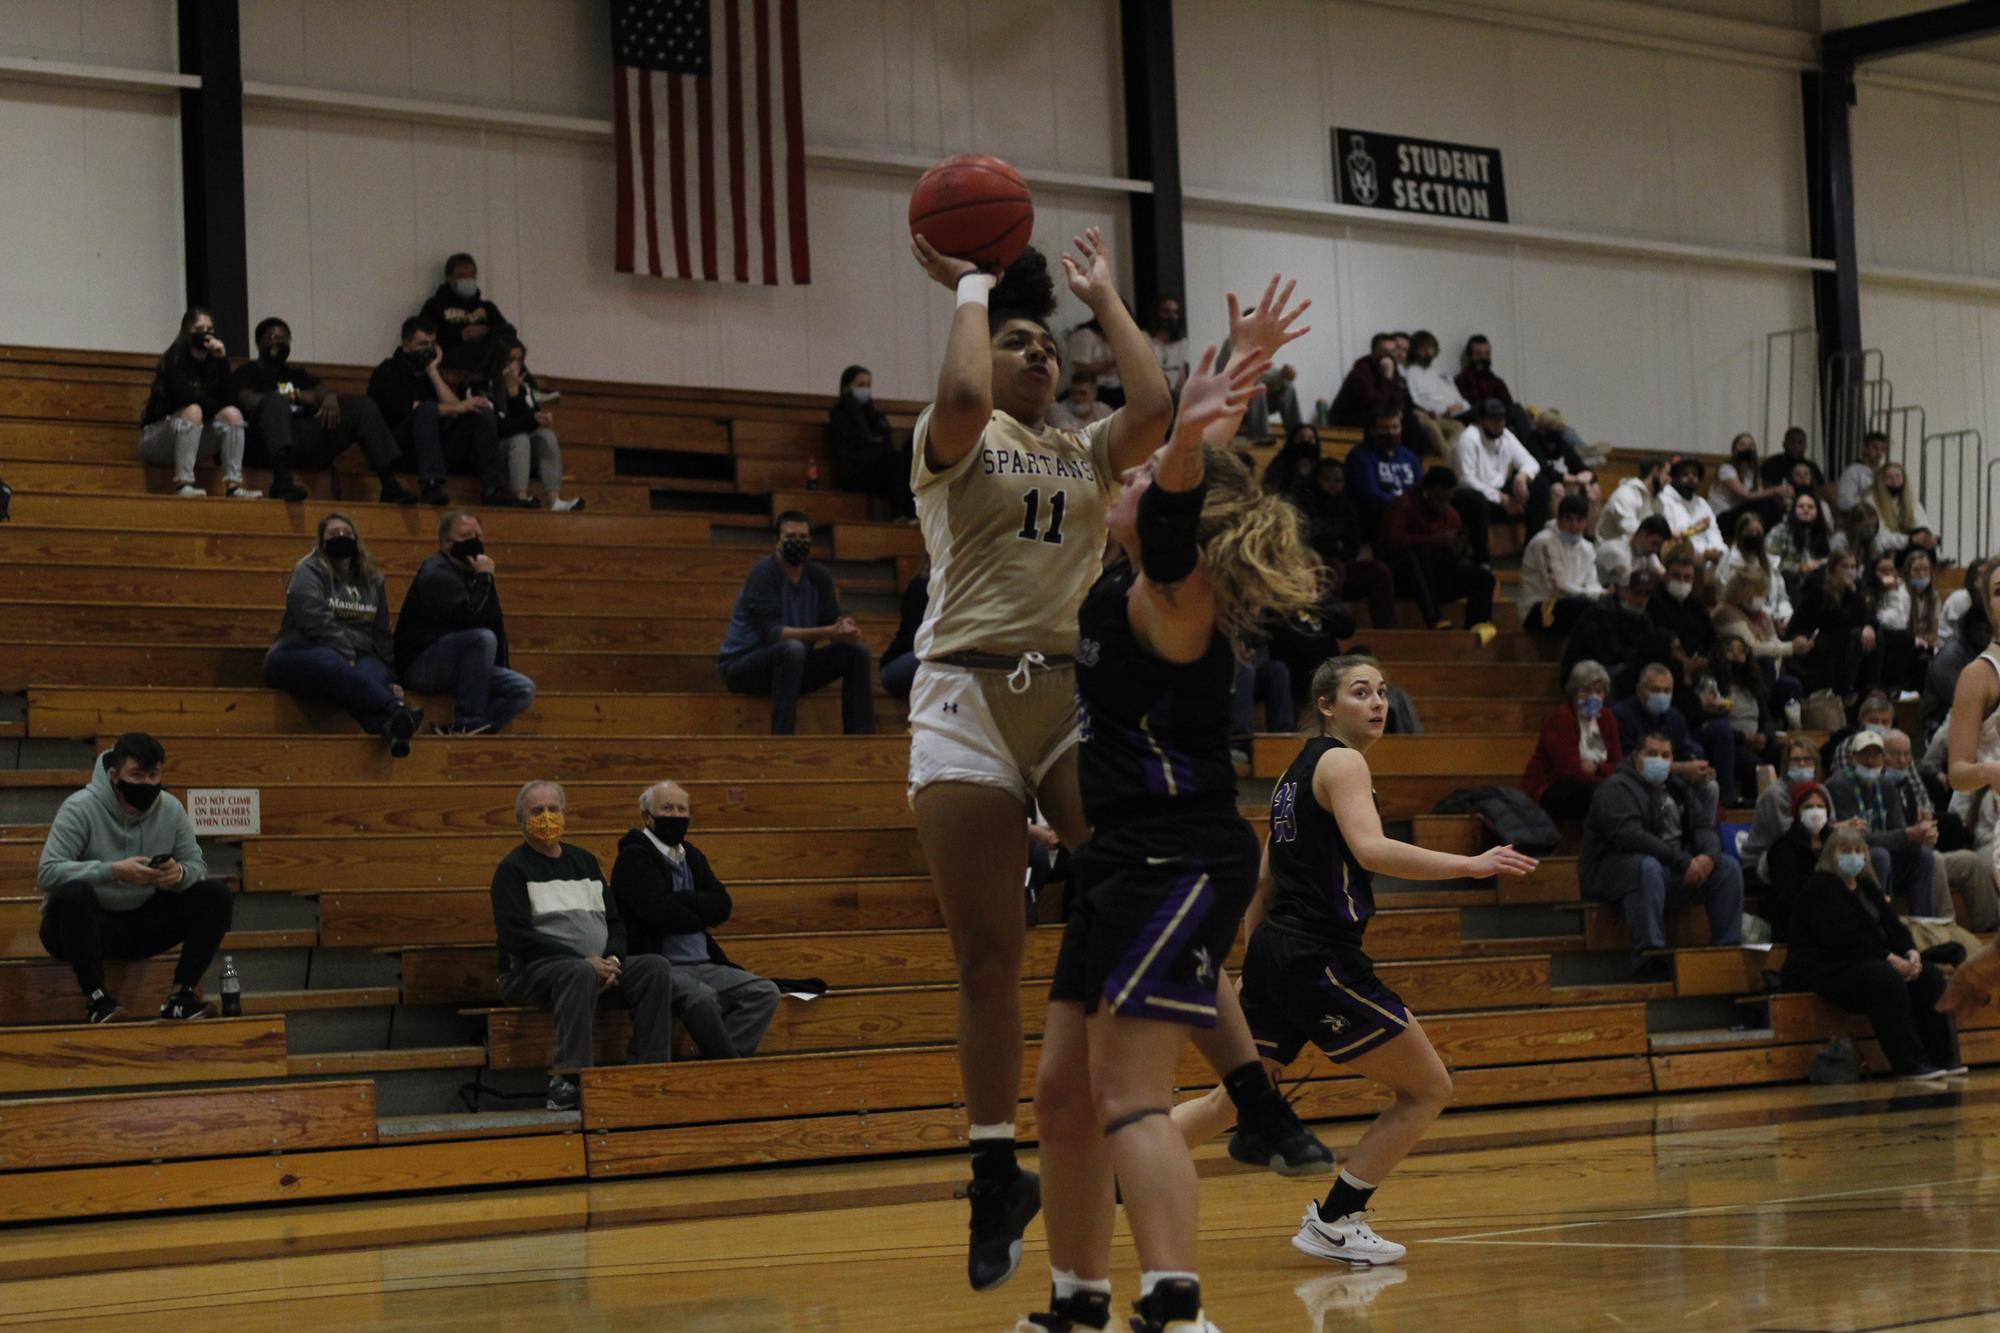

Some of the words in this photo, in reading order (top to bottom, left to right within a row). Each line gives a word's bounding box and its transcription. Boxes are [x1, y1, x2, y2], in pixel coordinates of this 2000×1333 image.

[1397, 144, 1490, 183] STUDENT
[1392, 178, 1490, 218] SECTION
[983, 449, 1094, 481] SPARTANS
[1018, 488, 1066, 545] 11
[194, 796, 207, 805] DO
[209, 796, 225, 805] NOT
[228, 796, 251, 805] CLIMB
[195, 807, 207, 816] ON
[209, 807, 250, 817] BLEACHERS
[195, 818, 219, 826] WHEN
[221, 818, 251, 826] CLOSED
